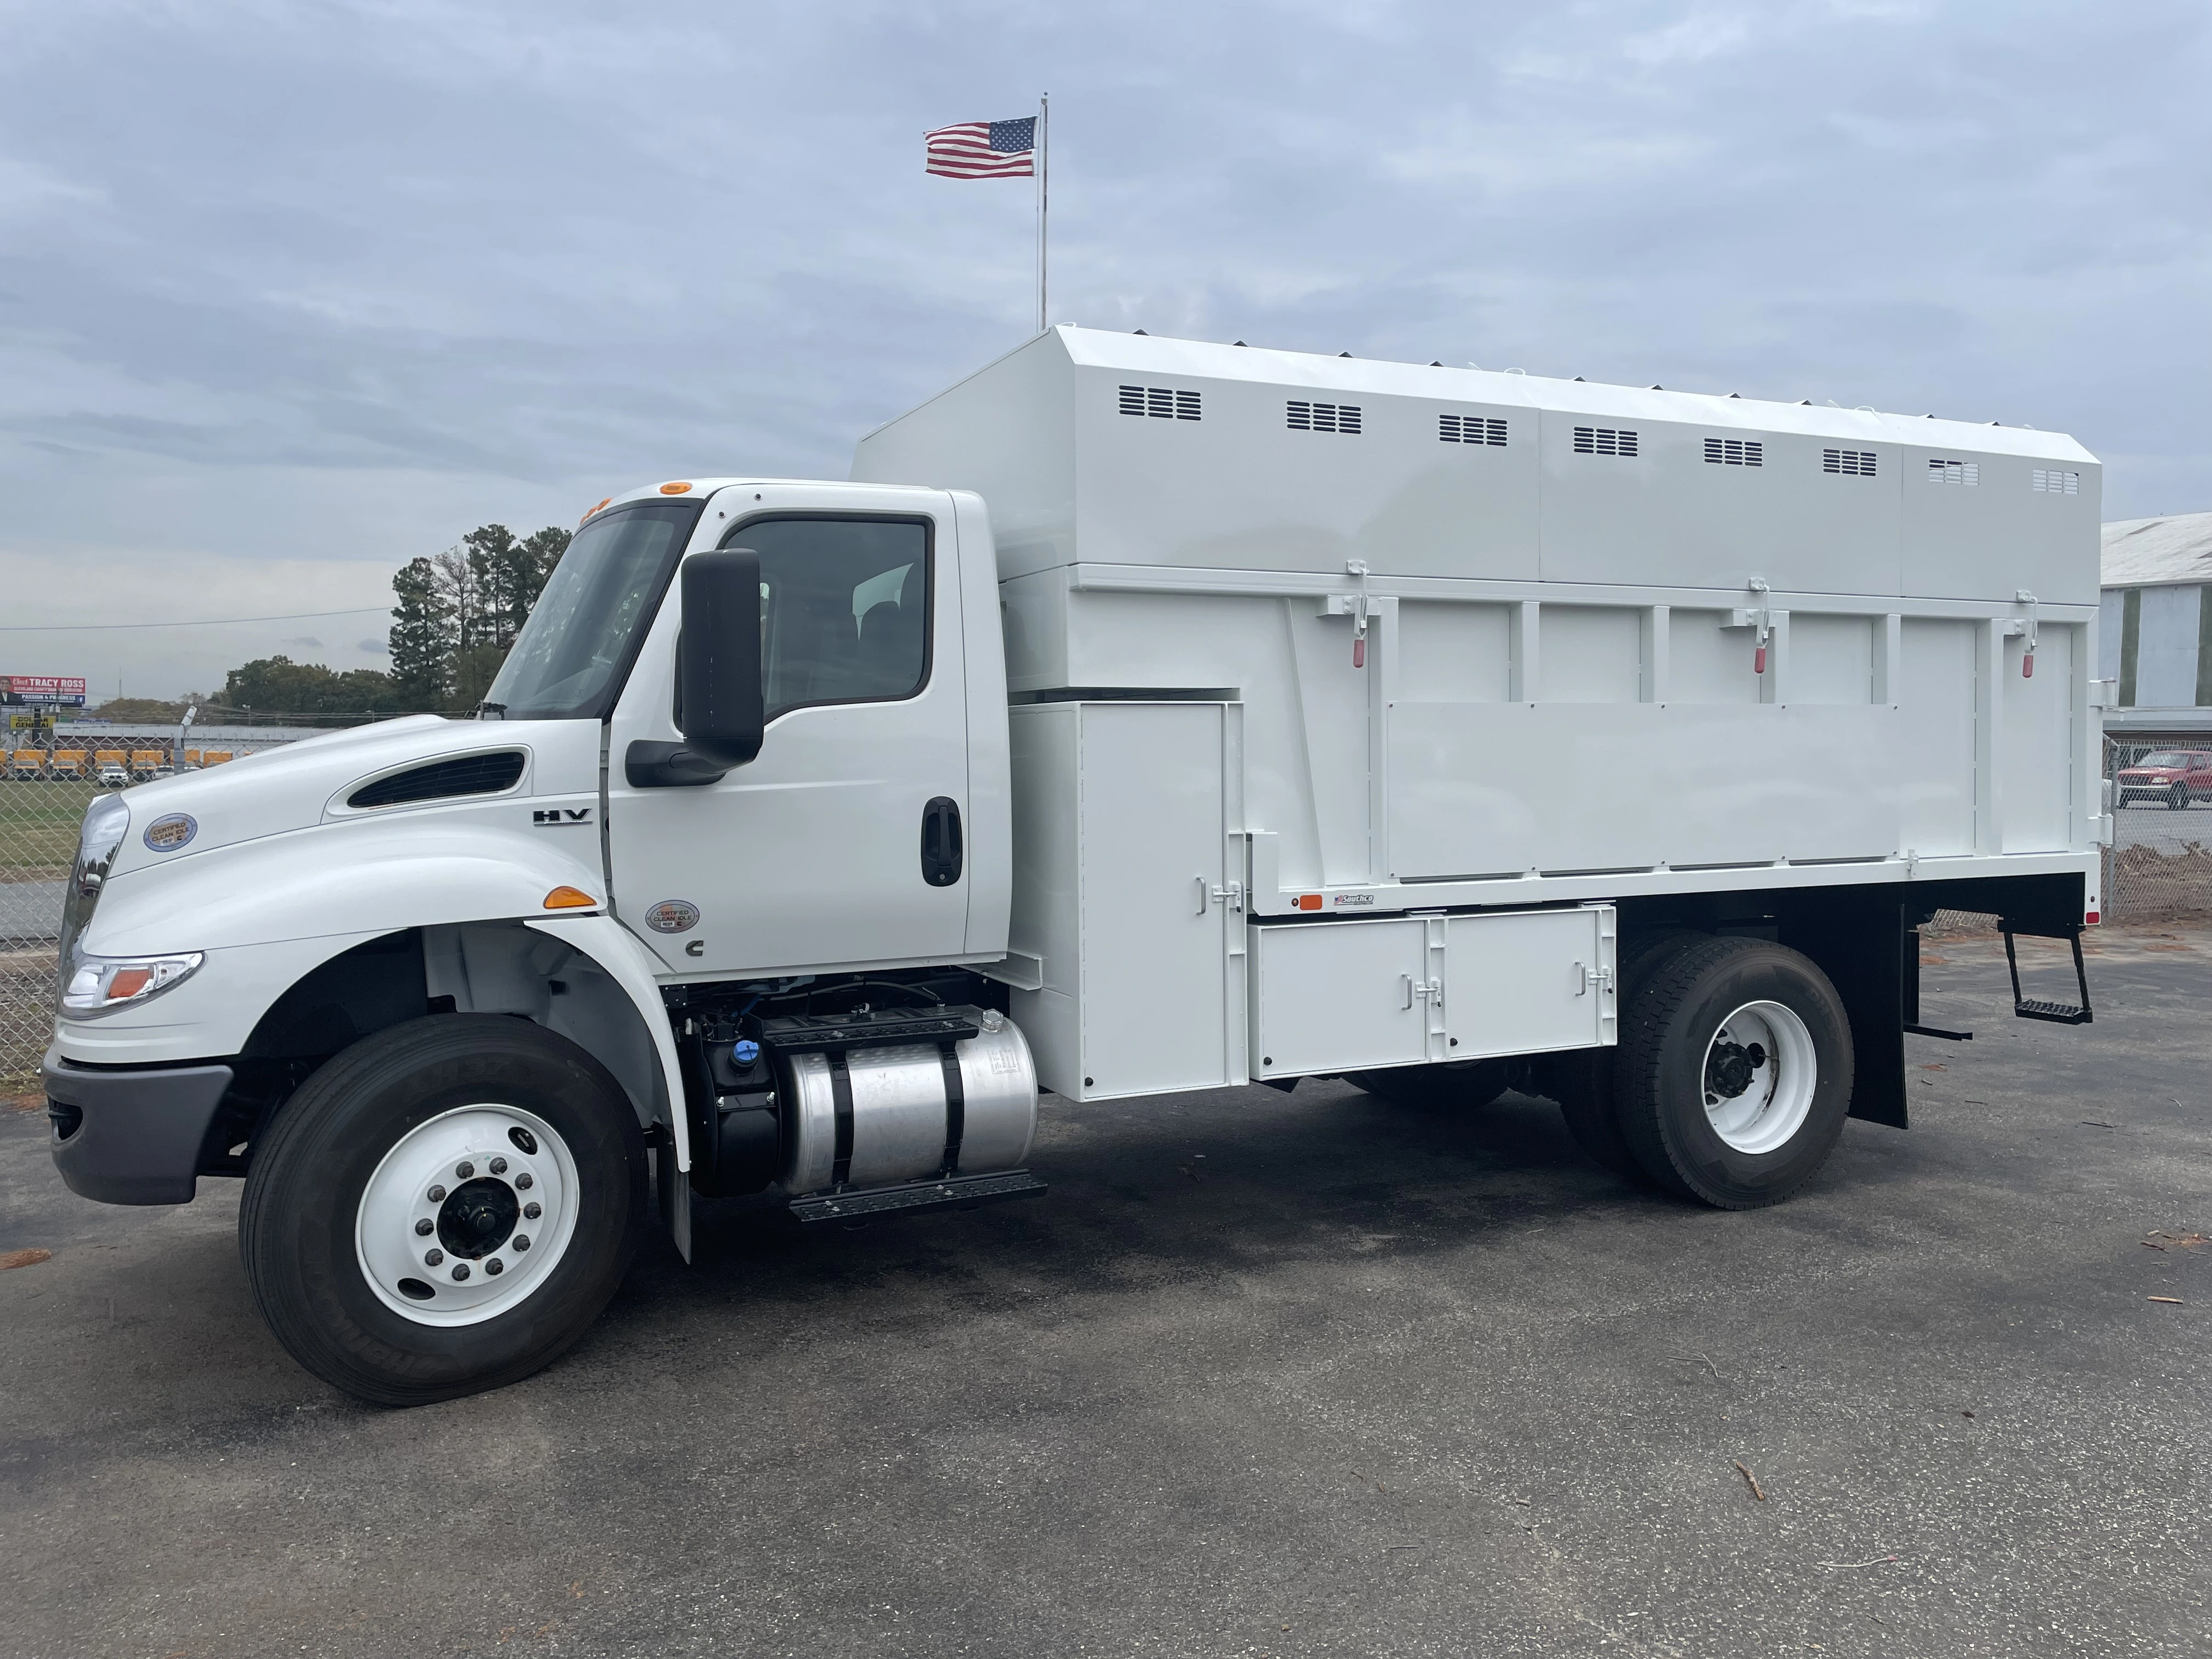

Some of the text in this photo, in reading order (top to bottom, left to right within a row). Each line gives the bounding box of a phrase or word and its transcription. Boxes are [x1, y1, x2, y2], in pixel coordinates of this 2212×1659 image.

[29, 678, 58, 687] TRACY
[61, 679, 84, 688] ROSS
[533, 808, 591, 822] HV
[154, 822, 185, 835] CERTIFIED
[152, 832, 173, 842] CLEAN
[1343, 895, 1374, 903] Southco
